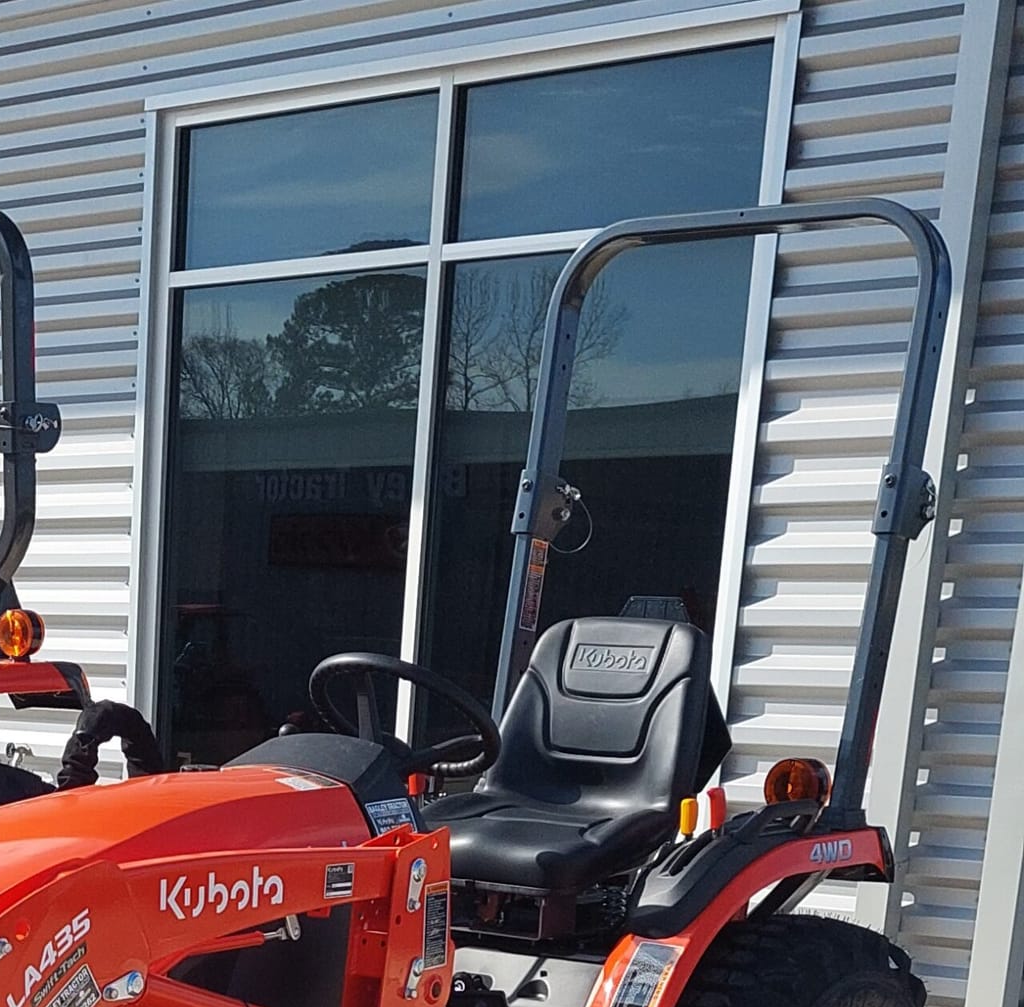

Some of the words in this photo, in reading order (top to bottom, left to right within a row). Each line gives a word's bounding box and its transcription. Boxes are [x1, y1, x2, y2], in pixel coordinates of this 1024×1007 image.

[578, 648, 648, 670] Kubota
[809, 839, 852, 864] 4WD
[159, 866, 283, 919] Kubota
[33, 946, 85, 1005] Swift-Tach
[61, 968, 89, 1001] TRACTOR
